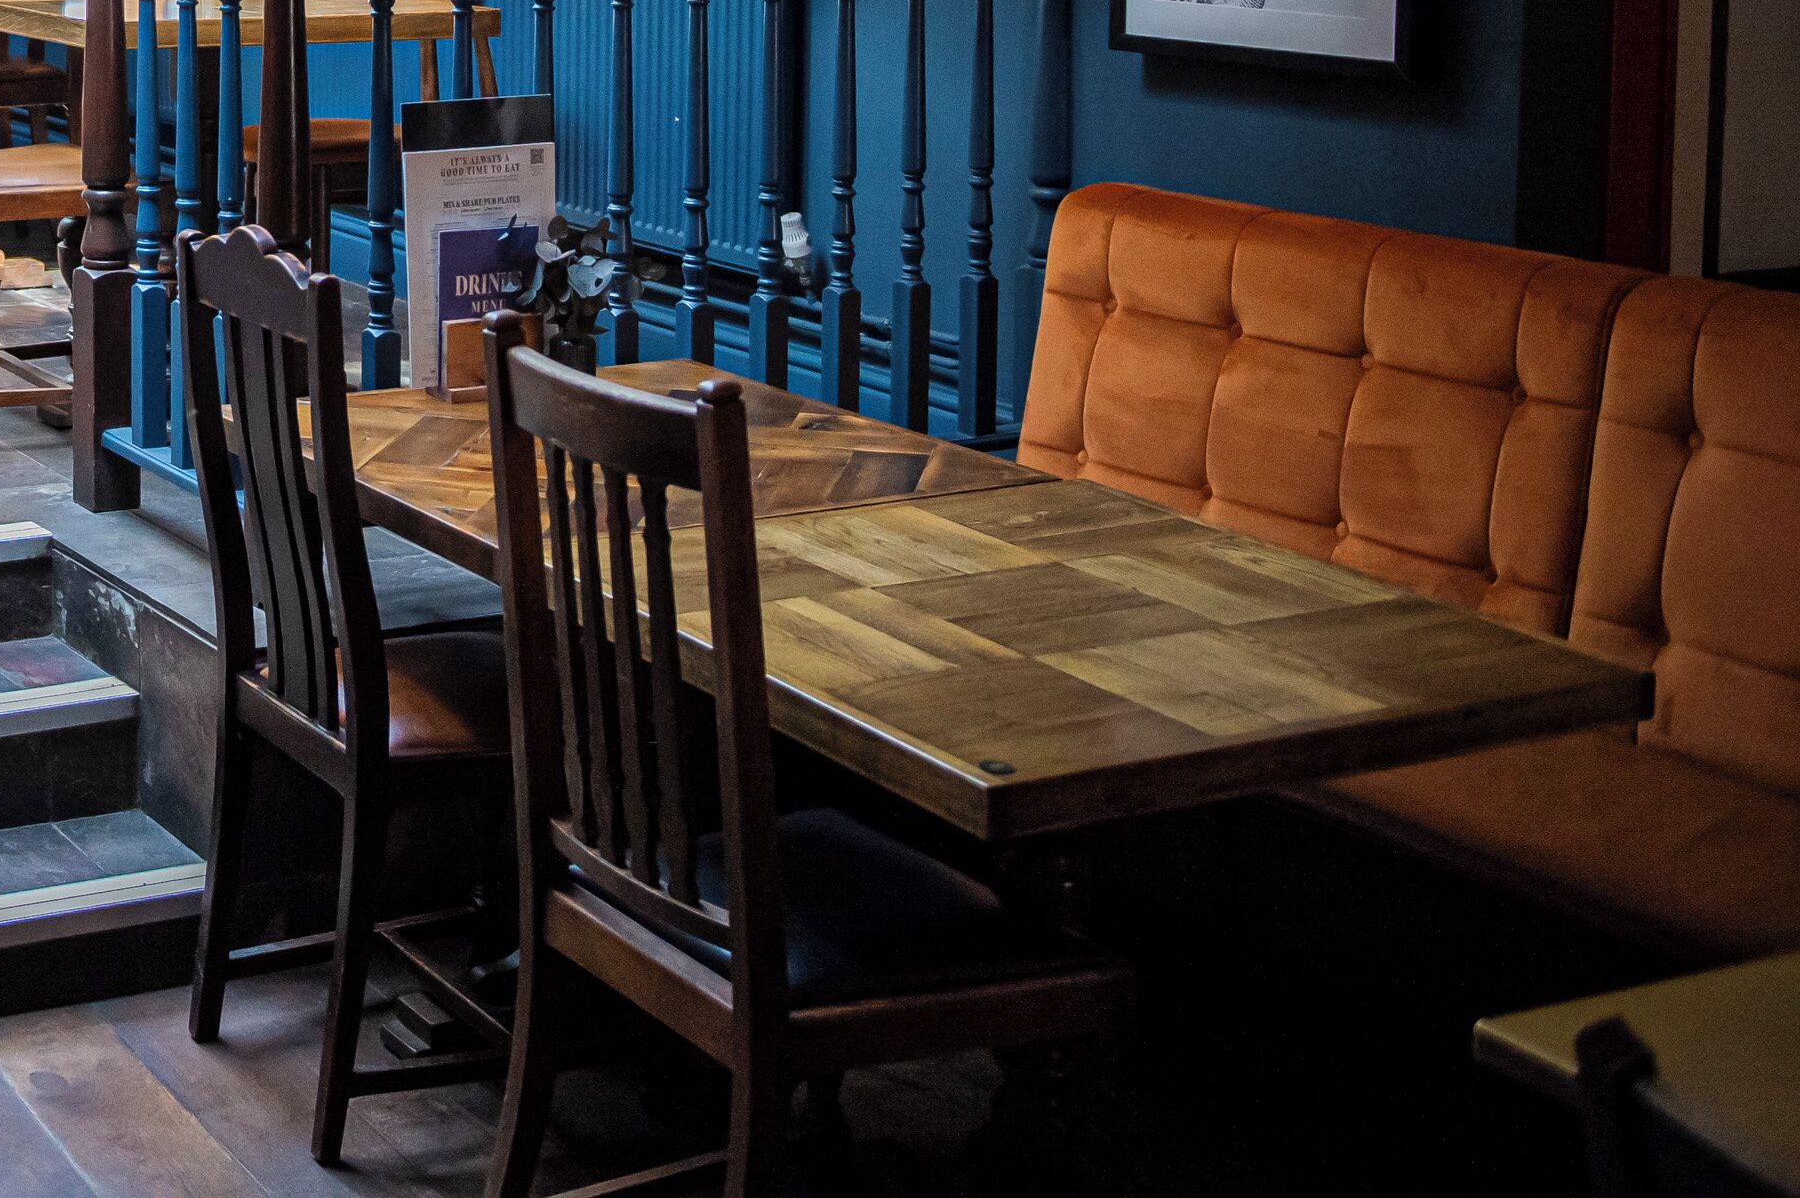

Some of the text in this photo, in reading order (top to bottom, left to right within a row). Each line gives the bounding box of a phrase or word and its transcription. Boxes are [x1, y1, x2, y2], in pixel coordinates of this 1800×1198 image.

[450, 154, 510, 166] IT'S ALWAYS A
[440, 167, 464, 177] GOOD
[467, 165, 488, 176] TIME
[492, 164, 502, 174] TO
[504, 163, 520, 173] EAT
